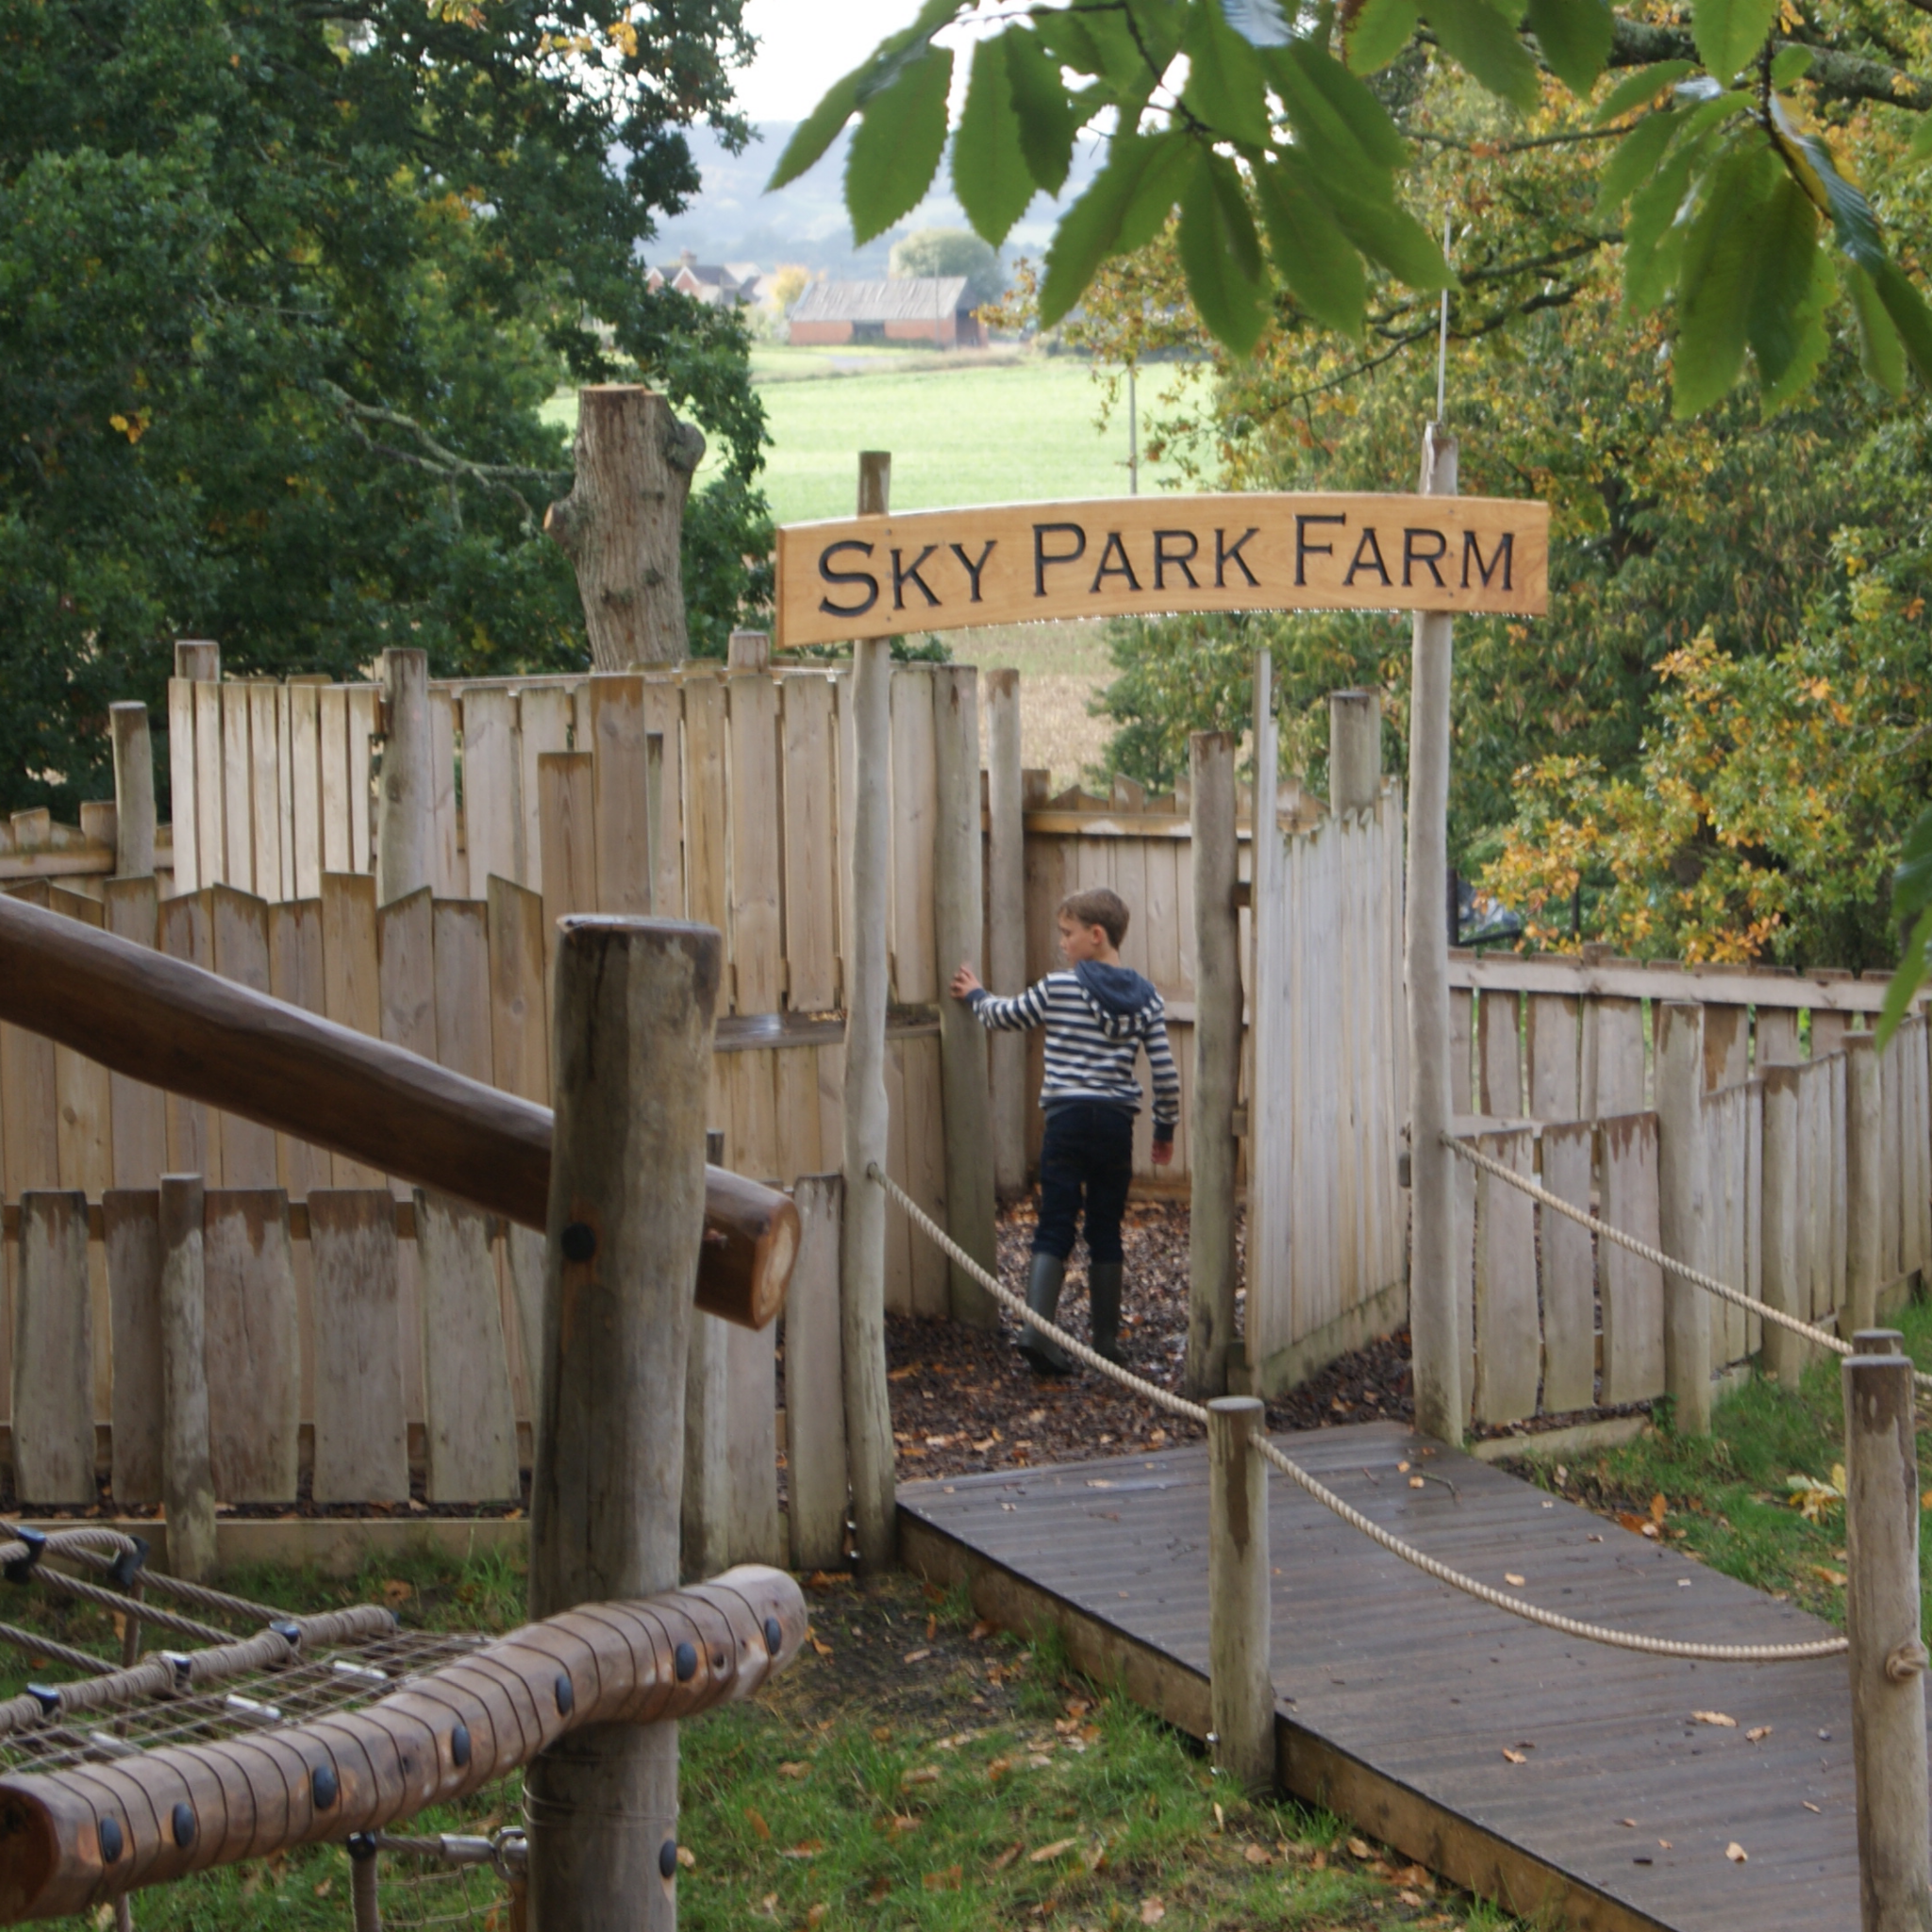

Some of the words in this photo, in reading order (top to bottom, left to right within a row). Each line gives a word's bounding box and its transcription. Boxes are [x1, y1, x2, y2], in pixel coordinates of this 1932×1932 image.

[818, 540, 997, 618] SKY
[1033, 522, 1260, 597] PARK
[1294, 513, 1513, 591] FARM
